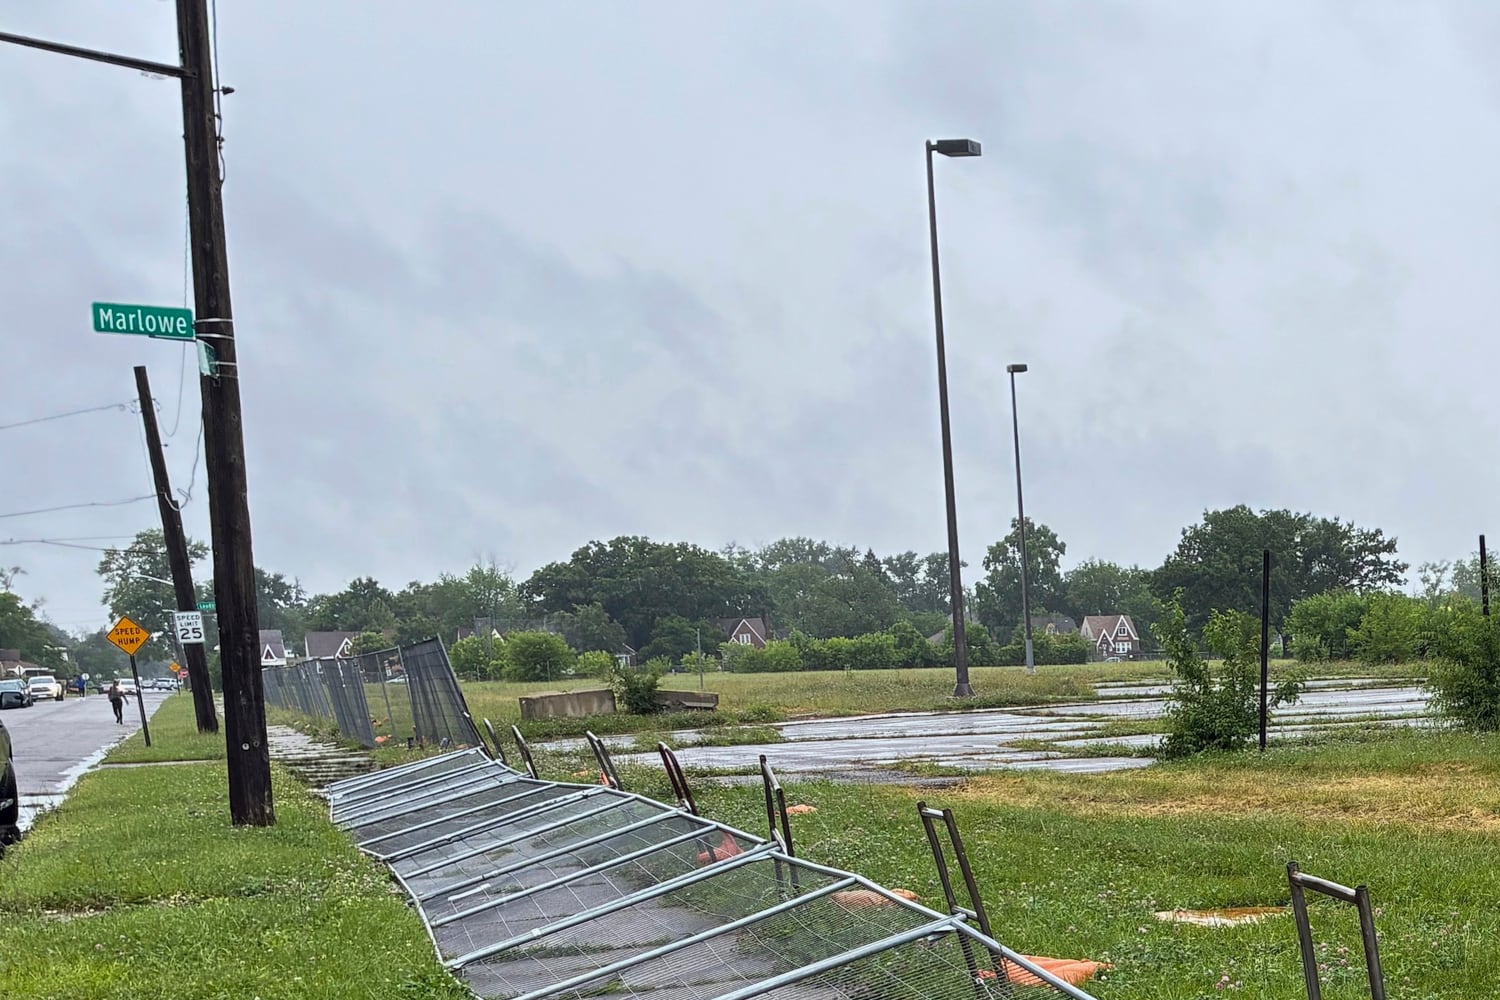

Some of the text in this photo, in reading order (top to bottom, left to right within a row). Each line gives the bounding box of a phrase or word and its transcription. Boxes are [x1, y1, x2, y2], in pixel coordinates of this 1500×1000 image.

[99, 308, 187, 334] Marlowe
[180, 628, 203, 639] 25
[118, 637, 140, 645] HUMP
